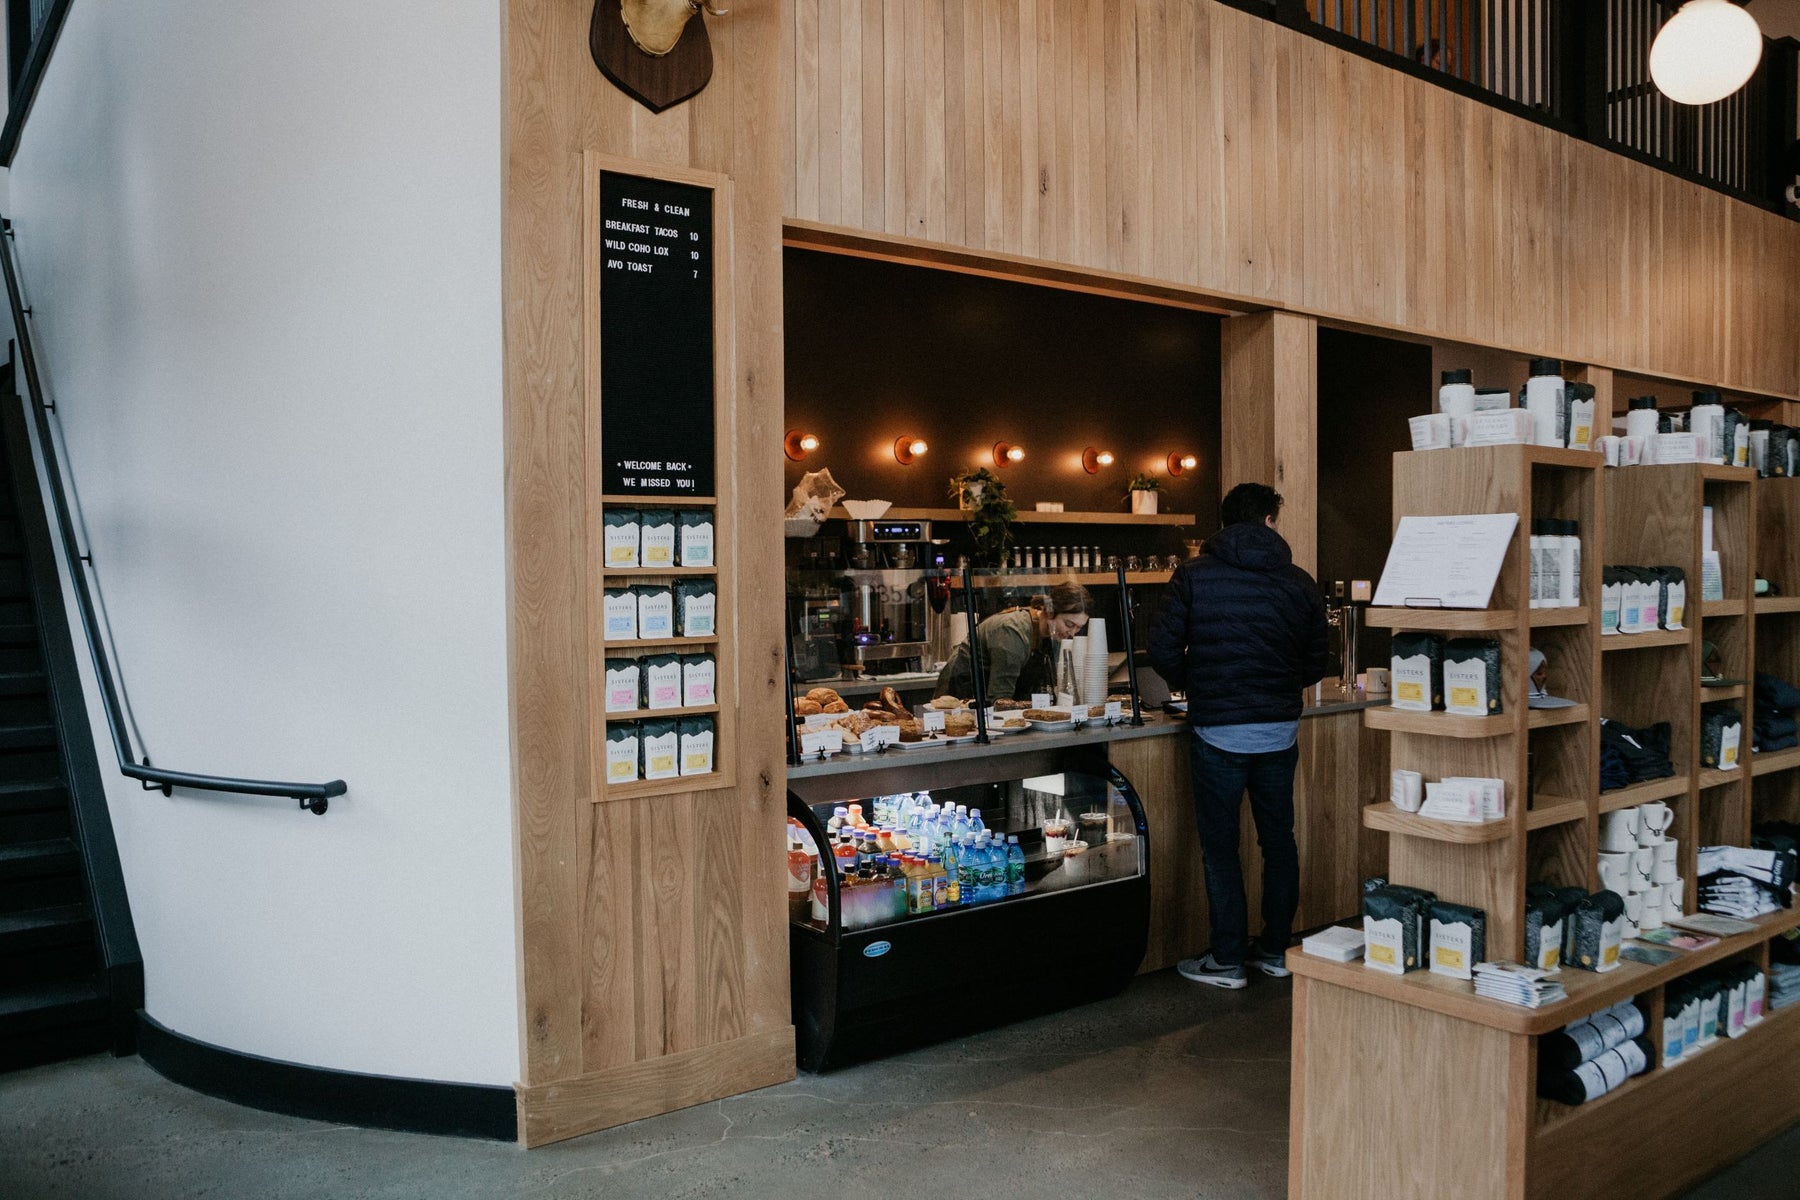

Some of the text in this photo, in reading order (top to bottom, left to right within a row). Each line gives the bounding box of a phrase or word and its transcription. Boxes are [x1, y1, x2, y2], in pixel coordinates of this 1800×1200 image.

[622, 198, 690, 216] FRESH & CLEAN
[605, 220, 699, 241] BREAKFAST TACOS 10
[605, 239, 699, 260] WILD COHO LOX 10
[607, 259, 698, 279] AVO TOAST 7
[624, 460, 687, 471] WELCOME BACK
[623, 477, 695, 491] WE MISSED YOU!
